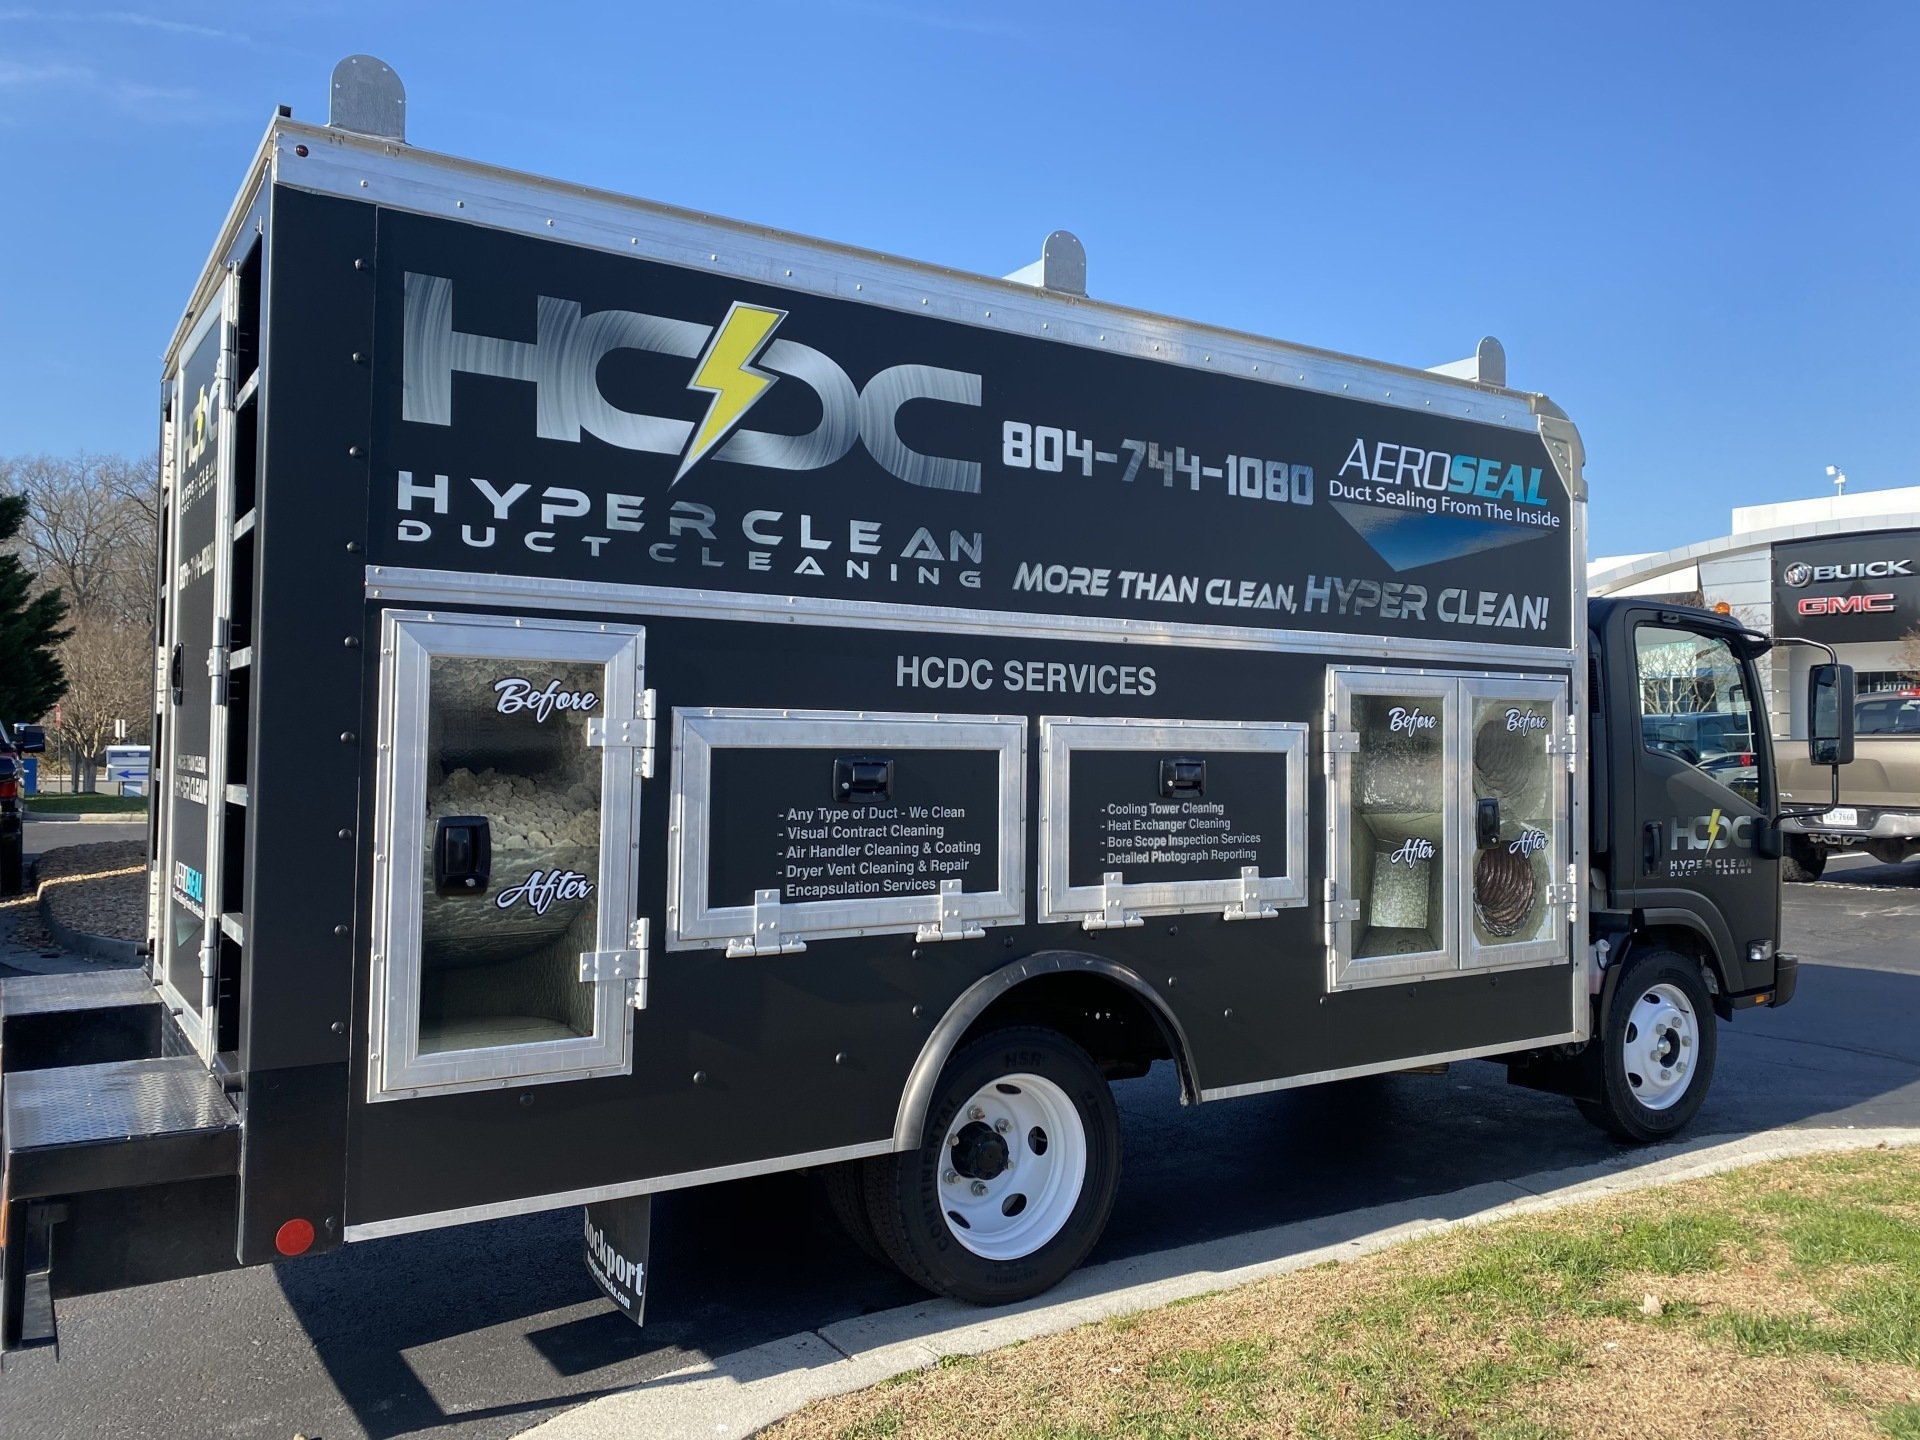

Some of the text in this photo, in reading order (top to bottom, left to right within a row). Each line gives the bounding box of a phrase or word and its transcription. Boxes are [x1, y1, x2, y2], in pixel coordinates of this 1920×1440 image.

[402, 271, 982, 494] HCDC
[1002, 420, 1314, 505] 804-744-1080
[1338, 438, 1548, 506] AEROSEAL
[398, 470, 982, 564] HYPER CLEAN
[1329, 480, 1560, 528] Duct Sealing From The Inside
[398, 520, 982, 588] DUCT CLEANING
[1814, 560, 1915, 580] BUICK
[1012, 561, 1550, 631] MORE THAN CLEAN, HYPER CLEAN!
[1798, 593, 1895, 615] GMC
[897, 655, 1157, 696] HCDC SERVICES
[493, 677, 600, 723] Before
[1388, 706, 1437, 738] Before
[1505, 708, 1548, 737] Before
[787, 808, 814, 824] Any
[818, 807, 849, 823] Type
[852, 806, 866, 820] of
[869, 807, 898, 820] Duct
[909, 806, 928, 819] We
[931, 806, 965, 819] Clean
[1108, 803, 1147, 816] Cooling
[1149, 803, 1180, 814] Tower
[1182, 802, 1225, 815] Cleaning
[787, 826, 828, 840] Visual
[832, 825, 887, 839] Contract
[891, 824, 944, 839] Cleaning
[1107, 820, 1131, 831] Heat
[1134, 818, 1186, 832] Exchanger
[1189, 818, 1231, 831] Cleaning
[786, 846, 806, 859] Air
[809, 844, 861, 858] Handler
[864, 843, 919, 857] Cleaning
[923, 842, 932, 854] &
[935, 841, 981, 855] Coating
[1107, 836, 1132, 848] Bore
[1134, 835, 1167, 849] Scope
[1168, 834, 1219, 848] Inspection
[1221, 833, 1261, 844] Services
[1390, 838, 1436, 868] After
[1509, 831, 1549, 859] After
[786, 865, 824, 880] Dryer
[827, 863, 856, 876] Vent
[859, 861, 914, 876] Cleaning
[918, 860, 927, 872] &
[930, 858, 969, 875] Repair
[1107, 851, 1149, 864] Detailed
[1151, 849, 1209, 864] Photograph
[1211, 848, 1257, 862] Reporting
[1670, 858, 1752, 870] HYPER CLEAN
[495, 869, 594, 915] After
[786, 879, 936, 898] Encapsulation Services
[584, 1205, 645, 1297] Rockport
